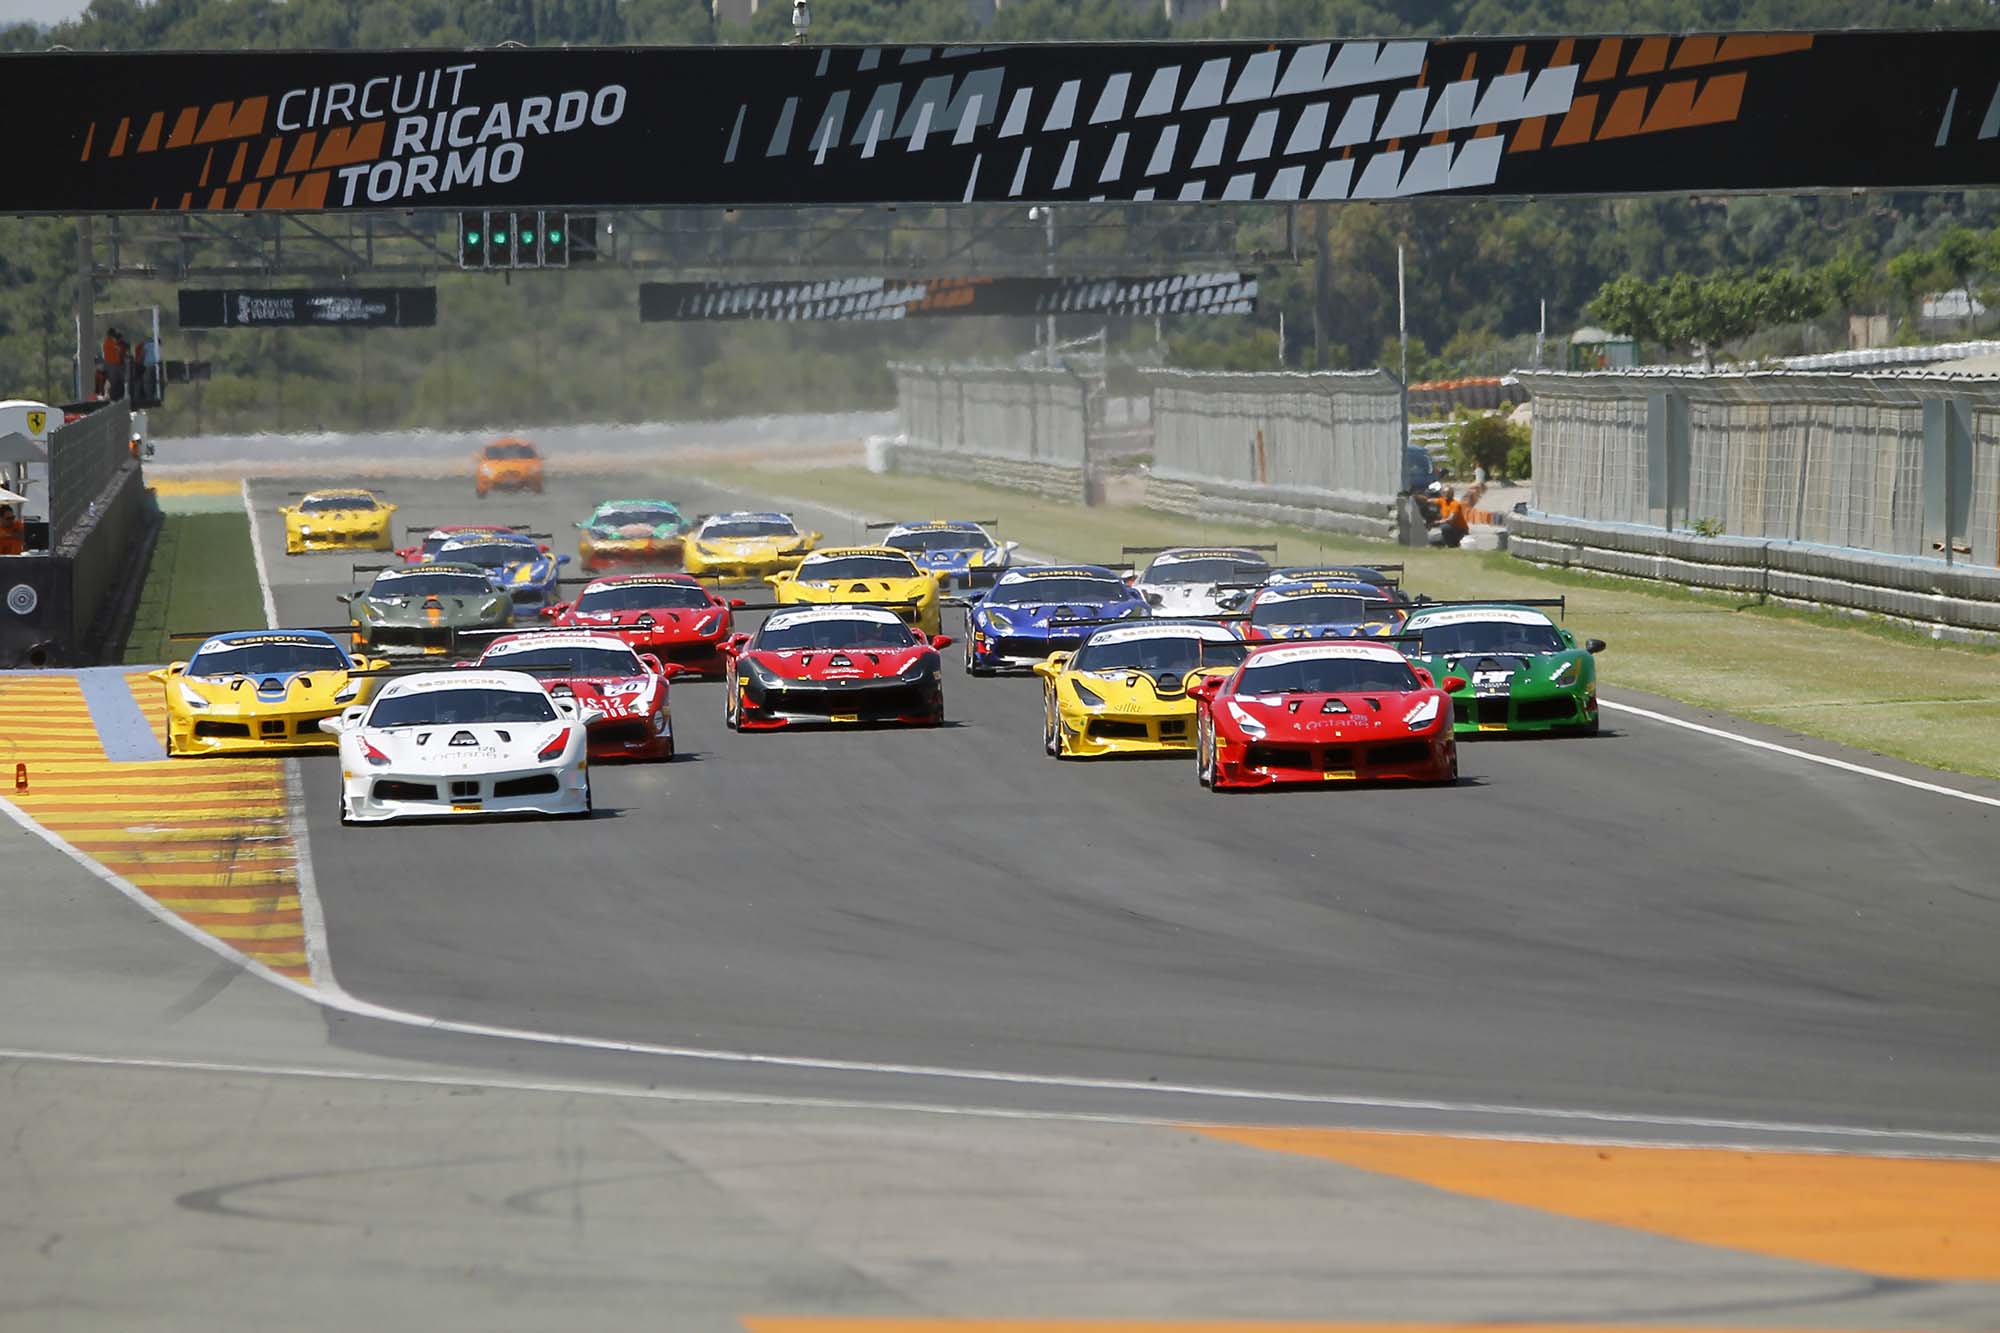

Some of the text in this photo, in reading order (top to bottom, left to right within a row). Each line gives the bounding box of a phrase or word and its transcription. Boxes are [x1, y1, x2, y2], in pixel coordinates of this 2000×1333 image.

[276, 63, 476, 131] CIRCUIT
[391, 84, 627, 157] RICARDO
[338, 142, 525, 207] TORMO
[488, 644, 508, 655] 20
